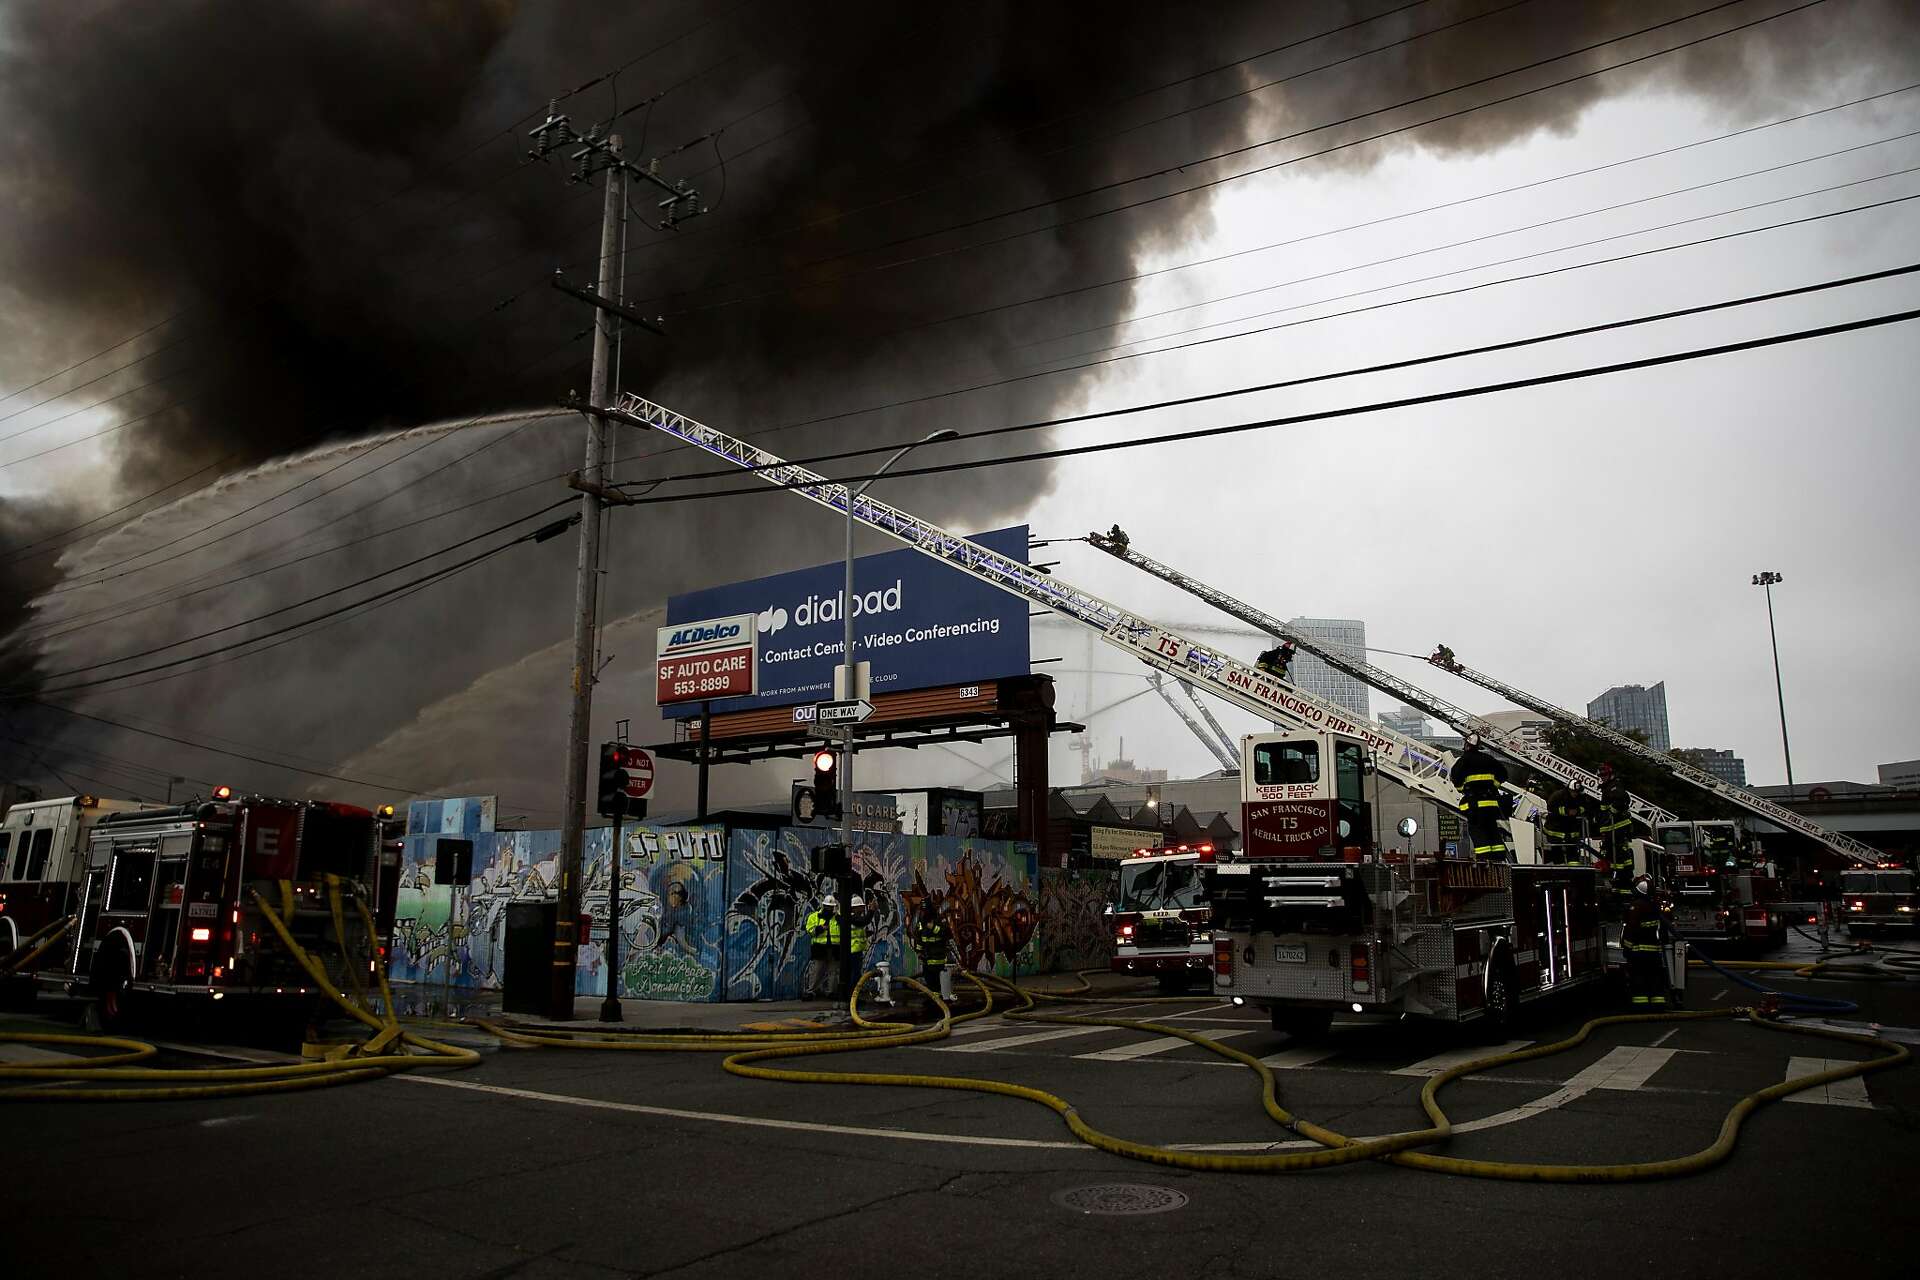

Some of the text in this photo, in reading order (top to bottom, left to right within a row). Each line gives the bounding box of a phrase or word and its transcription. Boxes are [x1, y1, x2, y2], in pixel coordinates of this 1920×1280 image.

[669, 624, 740, 646] ACDelco
[765, 645, 812, 664] Contact
[864, 632, 903, 648] Video
[905, 618, 1000, 643] Conferencing
[1157, 637, 1180, 657] T5
[660, 656, 746, 680] SF AUTO CARE
[674, 676, 730, 695] 553-8899
[760, 688, 778, 697] WORK
[779, 686, 797, 696] FROM
[798, 682, 832, 693] ANYWHERE
[875, 673, 898, 683] CLOUD
[960, 687, 978, 698] 6343
[822, 707, 857, 718] ONE WAY
[1227, 671, 1251, 690] SAN
[1253, 682, 1322, 722] FRANCISCO
[1325, 716, 1356, 735] FIRE
[813, 726, 839, 737] FOLSOM
[635, 757, 650, 768] NOT
[1536, 753, 1596, 788] SAN FRANCISCO
[628, 779, 646, 789] NTER
[1288, 791, 1314, 799] FEET
[867, 804, 896, 819] CARE
[1251, 805, 1326, 820] SAN FRANCISCO
[1739, 792, 1751, 802] SAN
[1752, 798, 1787, 818] FRANCISCO
[1788, 813, 1802, 825] FIRE
[1280, 817, 1298, 829] T5
[256, 827, 280, 855] E
[1252, 826, 1328, 842] AERIAL TRUCK CO.
[628, 830, 725, 864] SF AUTO
